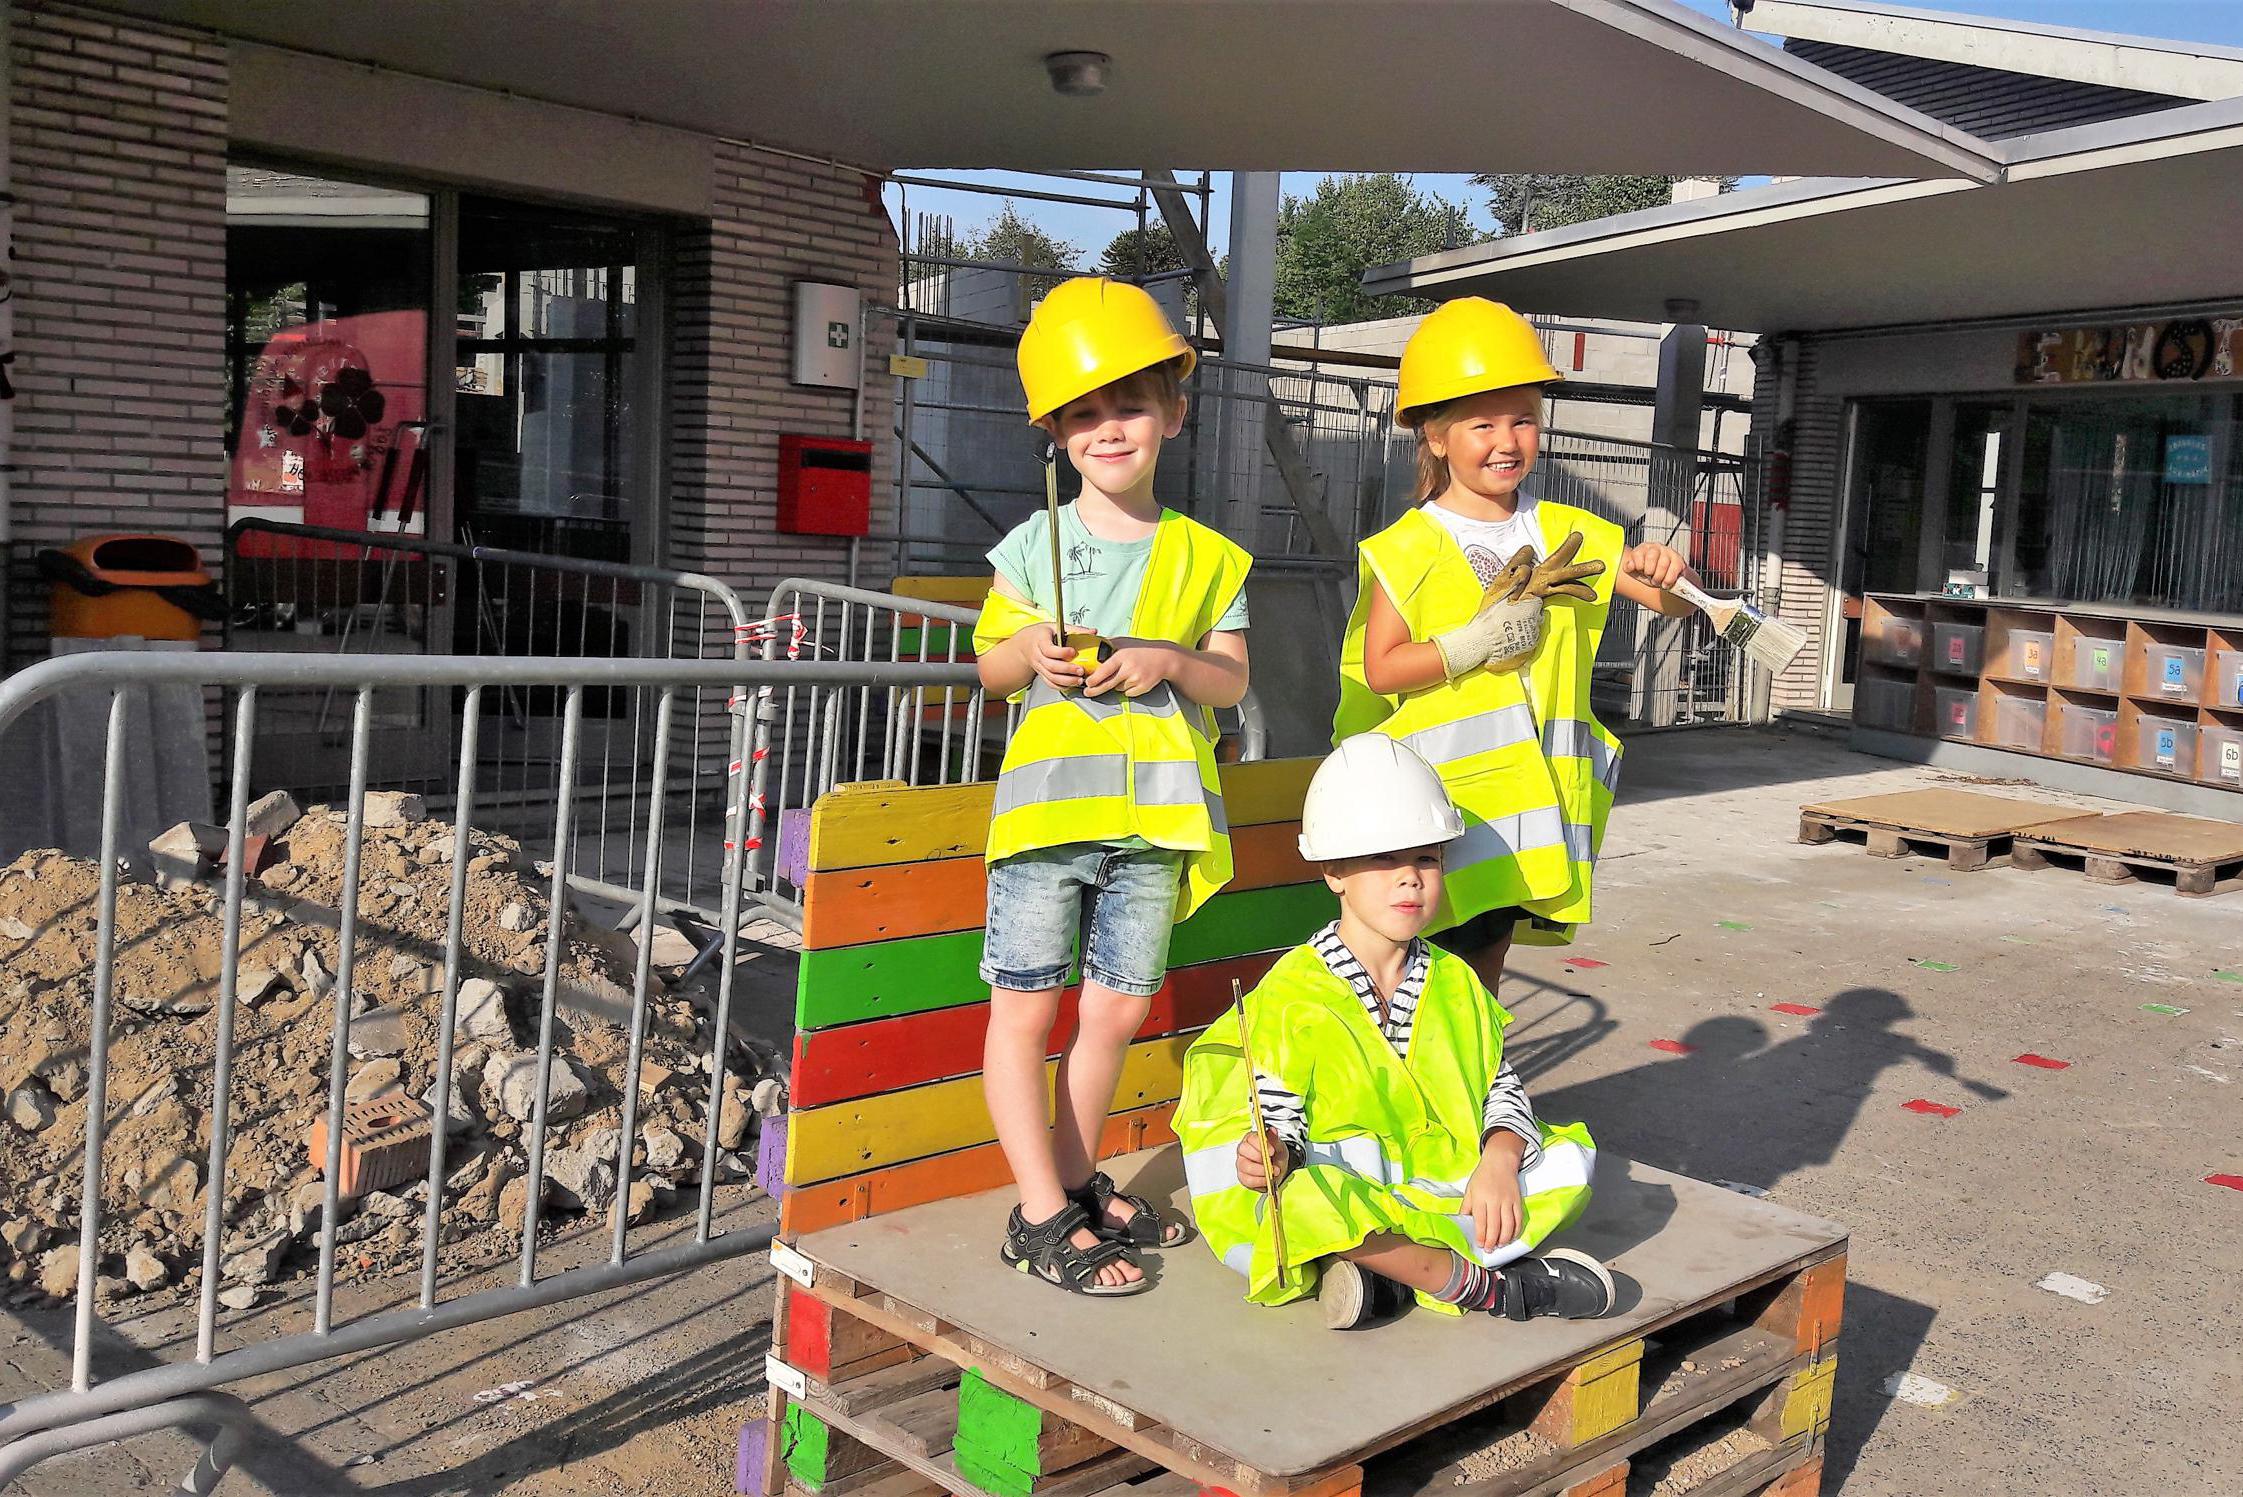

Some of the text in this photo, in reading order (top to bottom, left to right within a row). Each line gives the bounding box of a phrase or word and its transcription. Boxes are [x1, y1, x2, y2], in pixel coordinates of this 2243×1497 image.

[2027, 649, 2038, 660] 3a
[2096, 656, 2107, 666] 4a
[2168, 663, 2181, 676] 5a
[2160, 737, 2173, 749] 5b
[2225, 748, 2239, 760] 6b
